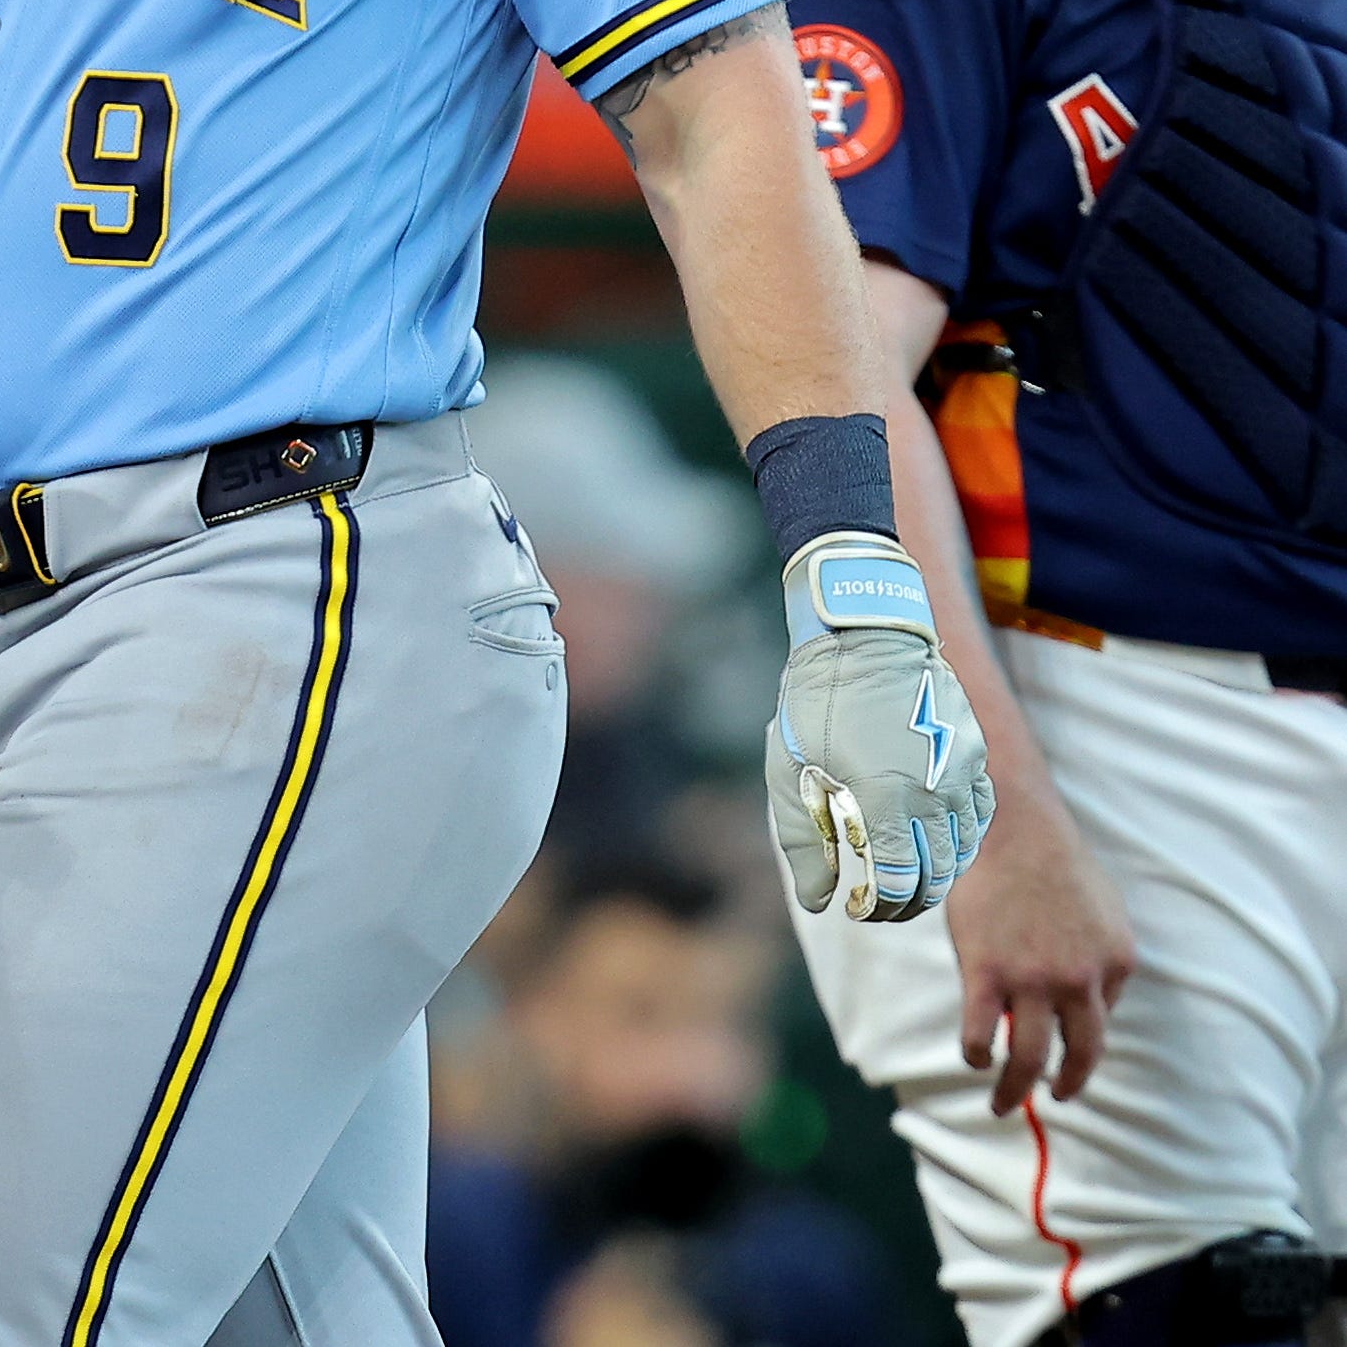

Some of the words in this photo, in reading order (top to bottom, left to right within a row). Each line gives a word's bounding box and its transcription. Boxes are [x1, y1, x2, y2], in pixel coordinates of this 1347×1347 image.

[53, 70, 179, 267] 9
[832, 580, 876, 597] BOLT
[885, 582, 925, 603] BRUCE
